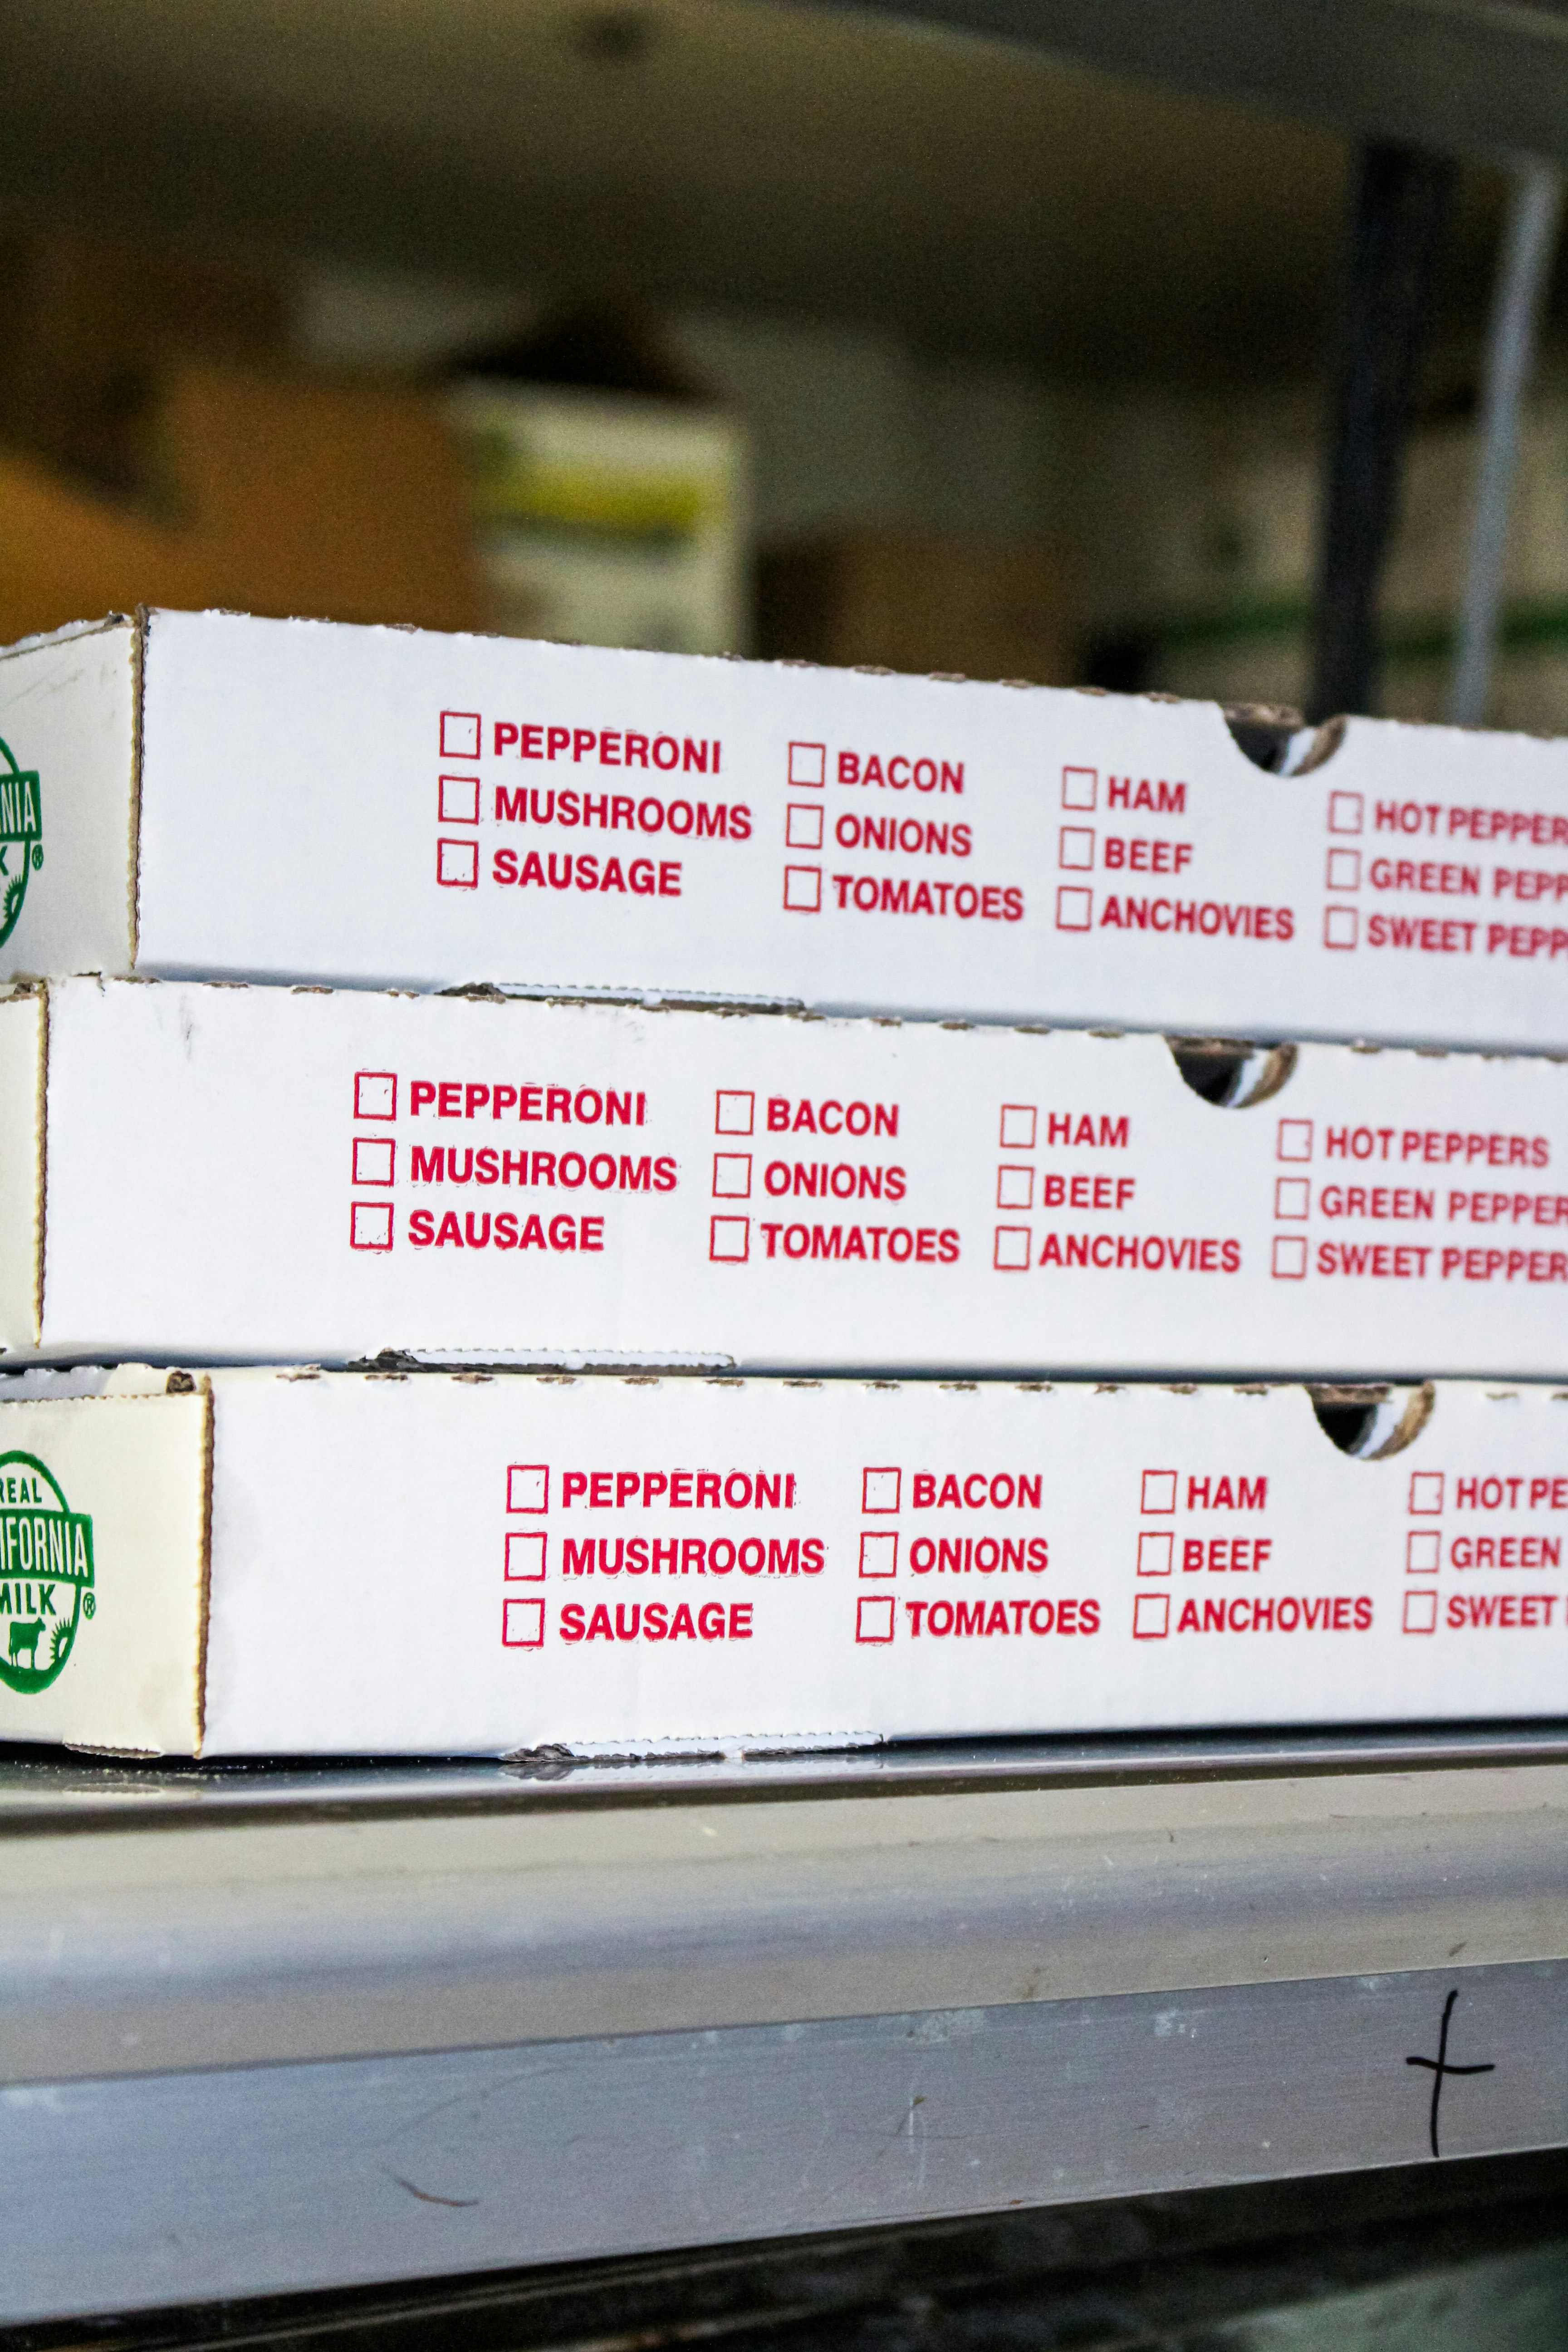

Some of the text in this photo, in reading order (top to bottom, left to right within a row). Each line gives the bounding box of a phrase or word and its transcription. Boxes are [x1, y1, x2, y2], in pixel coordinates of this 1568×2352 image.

[494, 721, 721, 775] PEPPERONI
[837, 751, 964, 795] BACON
[494, 785, 753, 841] MUSHROOMS
[1107, 776, 1186, 813] HAM
[835, 814, 972, 858] ONIONS
[1375, 802, 1568, 845] HOT PEPPER
[492, 848, 682, 897] SAUSAGE
[1104, 837, 1193, 875] BEEF
[1369, 858, 1480, 895] GREEN
[832, 874, 1024, 922] TOMATOES
[1099, 895, 1294, 941] ANCHOVIES
[1367, 914, 1477, 952] SWEET
[410, 1080, 647, 1127] PEPPERONI
[766, 1097, 899, 1138] BACON
[1047, 1112, 1130, 1148] HAM
[1326, 1126, 1549, 1168] HOT PEPPERS
[410, 1145, 678, 1193] MUSHROOMS
[764, 1160, 907, 1202] ONIONS
[1043, 1174, 1135, 1210] BEEF
[1319, 1185, 1435, 1220] GREEN
[407, 1209, 605, 1253] SAUSAGE
[760, 1222, 961, 1265] TOMATOES
[1038, 1232, 1241, 1274] ANCHOVIES
[1316, 1241, 1568, 1283] SWEET PEPPER
[562, 1470, 797, 1510] PEPPERONI
[912, 1472, 1043, 1510] BACON
[1186, 1475, 1268, 1511] HAM
[1456, 1476, 1524, 1510] HOT
[562, 1537, 825, 1577] MUSHROOMS
[909, 1536, 1049, 1575] ONIONS
[1181, 1538, 1273, 1573] BEEF
[1450, 1536, 1561, 1570] GREEN
[559, 1602, 754, 1642] SAUSAGE
[905, 1598, 1101, 1638] TOMATOES
[1176, 1596, 1373, 1633] ANCHOVIES
[1446, 1594, 1559, 1629] SWEET
